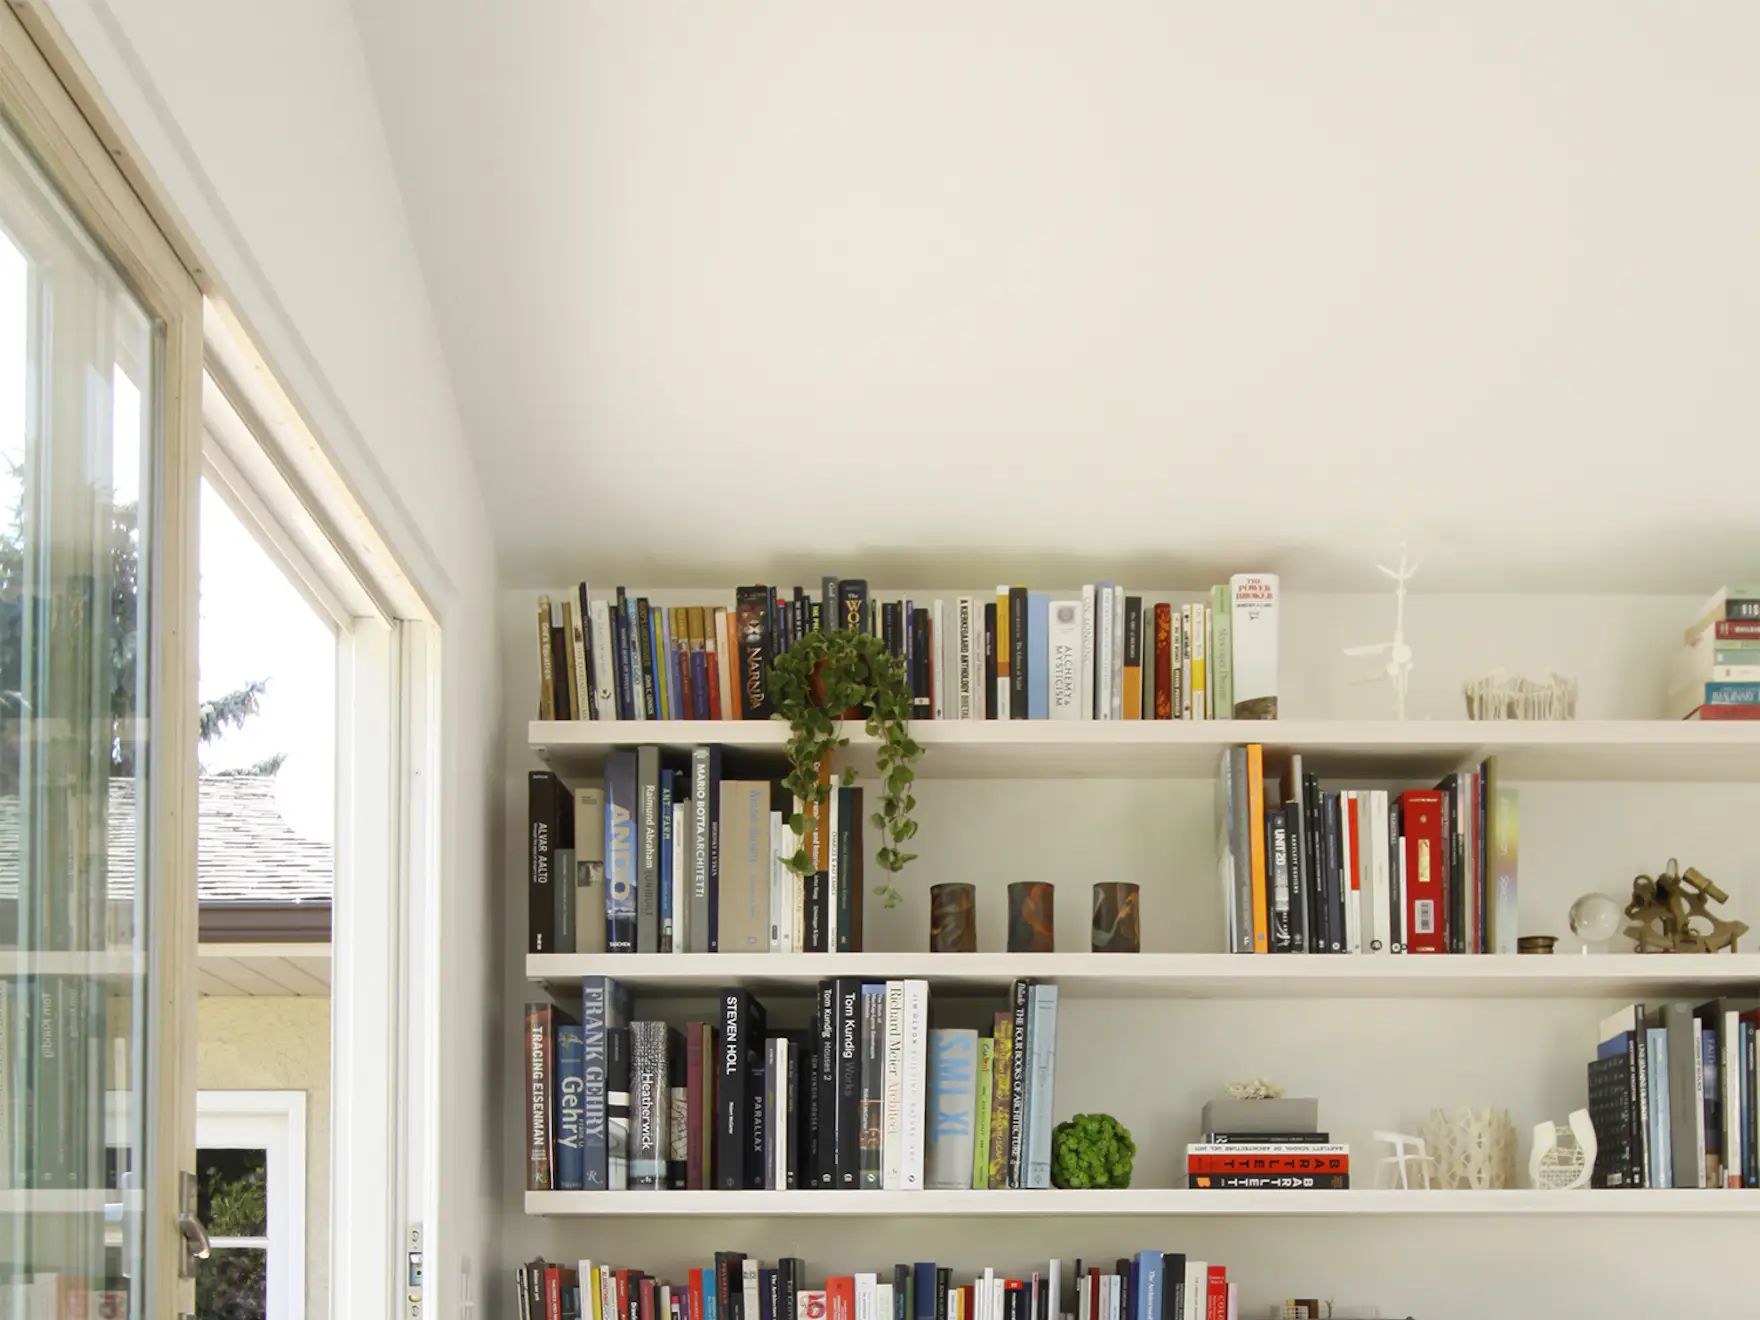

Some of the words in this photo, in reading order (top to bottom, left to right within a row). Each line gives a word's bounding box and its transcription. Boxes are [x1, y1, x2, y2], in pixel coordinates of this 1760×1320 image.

[960, 606, 969, 653] KIERKEGAARD
[746, 647, 764, 710] NARNIA
[961, 654, 969, 693] ANTHOLOGY
[1055, 645, 1063, 707] MYSTICISM
[1063, 645, 1073, 699] ALCHEMY
[662, 788, 670, 806] ANT
[696, 764, 705, 799] MARIO
[645, 785, 655, 825] Raimund
[696, 801, 705, 834] BOTTA
[538, 823, 547, 852] ALVAR
[610, 803, 630, 901] ANDO
[645, 827, 654, 868] Abraham
[1274, 829, 1286, 851] UNIT
[538, 856, 547, 883] AALTO
[695, 834, 705, 897] ARCHITETTI
[1275, 852, 1286, 865] 20
[824, 989, 832, 1007] Tom
[845, 992, 856, 1017] Tom
[889, 988, 902, 1036] Richard
[1016, 1008, 1024, 1025] THE
[585, 987, 603, 1062] FRANK
[726, 996, 737, 1043] STEVEN
[822, 1009, 832, 1038] Kundig
[843, 1019, 855, 1059] Kundig
[1015, 1027, 1023, 1049] FOUR
[532, 1026, 543, 1079] TRACING
[726, 1045, 737, 1075] HOLL
[888, 1040, 901, 1076] Meier
[1014, 1050, 1023, 1080] BOOKS
[845, 1061, 855, 1097] Works
[1013, 1082, 1023, 1093] OF
[532, 1083, 544, 1145] EISENMAN
[558, 1076, 583, 1149] Gehry
[586, 1066, 604, 1139] GEHRY
[642, 1073, 652, 1150] Heatherwick
[887, 1080, 901, 1135] Architect
[754, 1096, 762, 1152] PARALLAX
[1011, 1093, 1022, 1156] ARCHITECTURE
[1224, 1159, 1340, 1169] BARTLETT
[1228, 1177, 1314, 1187] BARTLETT
